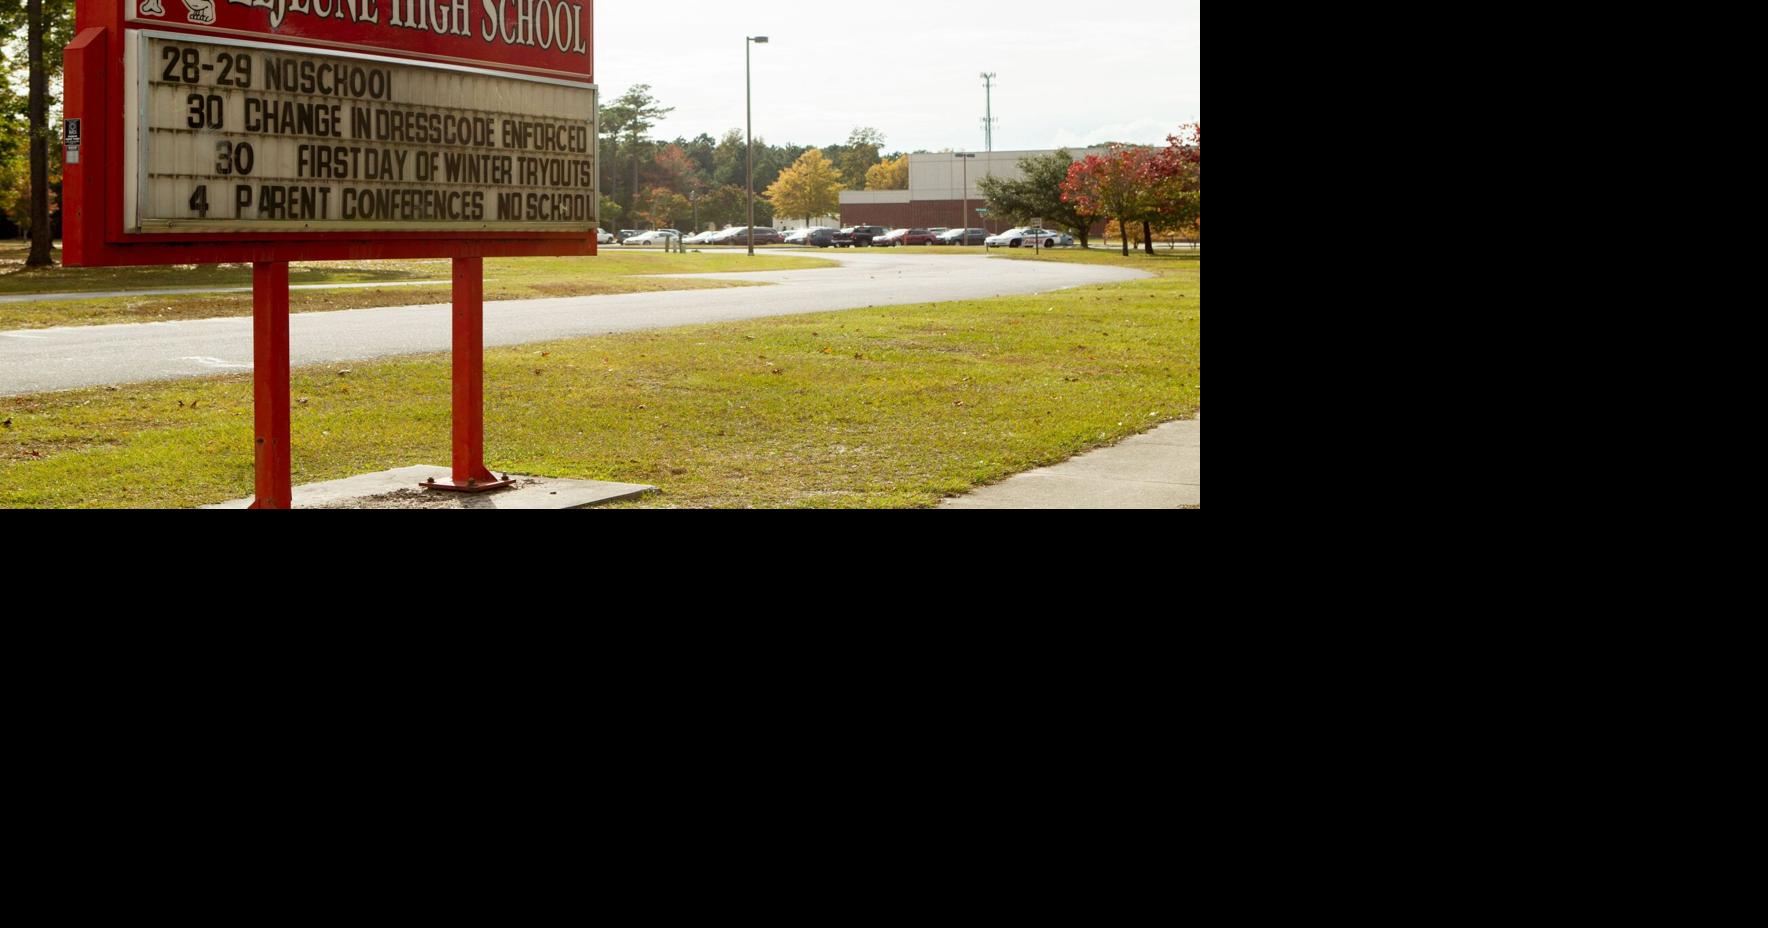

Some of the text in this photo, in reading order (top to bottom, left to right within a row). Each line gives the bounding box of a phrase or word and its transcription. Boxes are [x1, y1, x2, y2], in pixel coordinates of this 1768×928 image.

[482, 0, 586, 55] SCHOOL
[162, 46, 252, 89] 28-29
[187, 94, 224, 130] 30
[245, 97, 342, 138] CHANGE
[351, 106, 372, 140] IN
[502, 120, 587, 153] ENFORCED
[215, 140, 254, 176] 30
[416, 152, 439, 182] OF
[444, 153, 513, 185] WINTER
[517, 156, 591, 188] TRYOUTS
[189, 184, 209, 218] 4
[342, 187, 484, 221] CONFERENCES
[497, 192, 523, 221] NO
